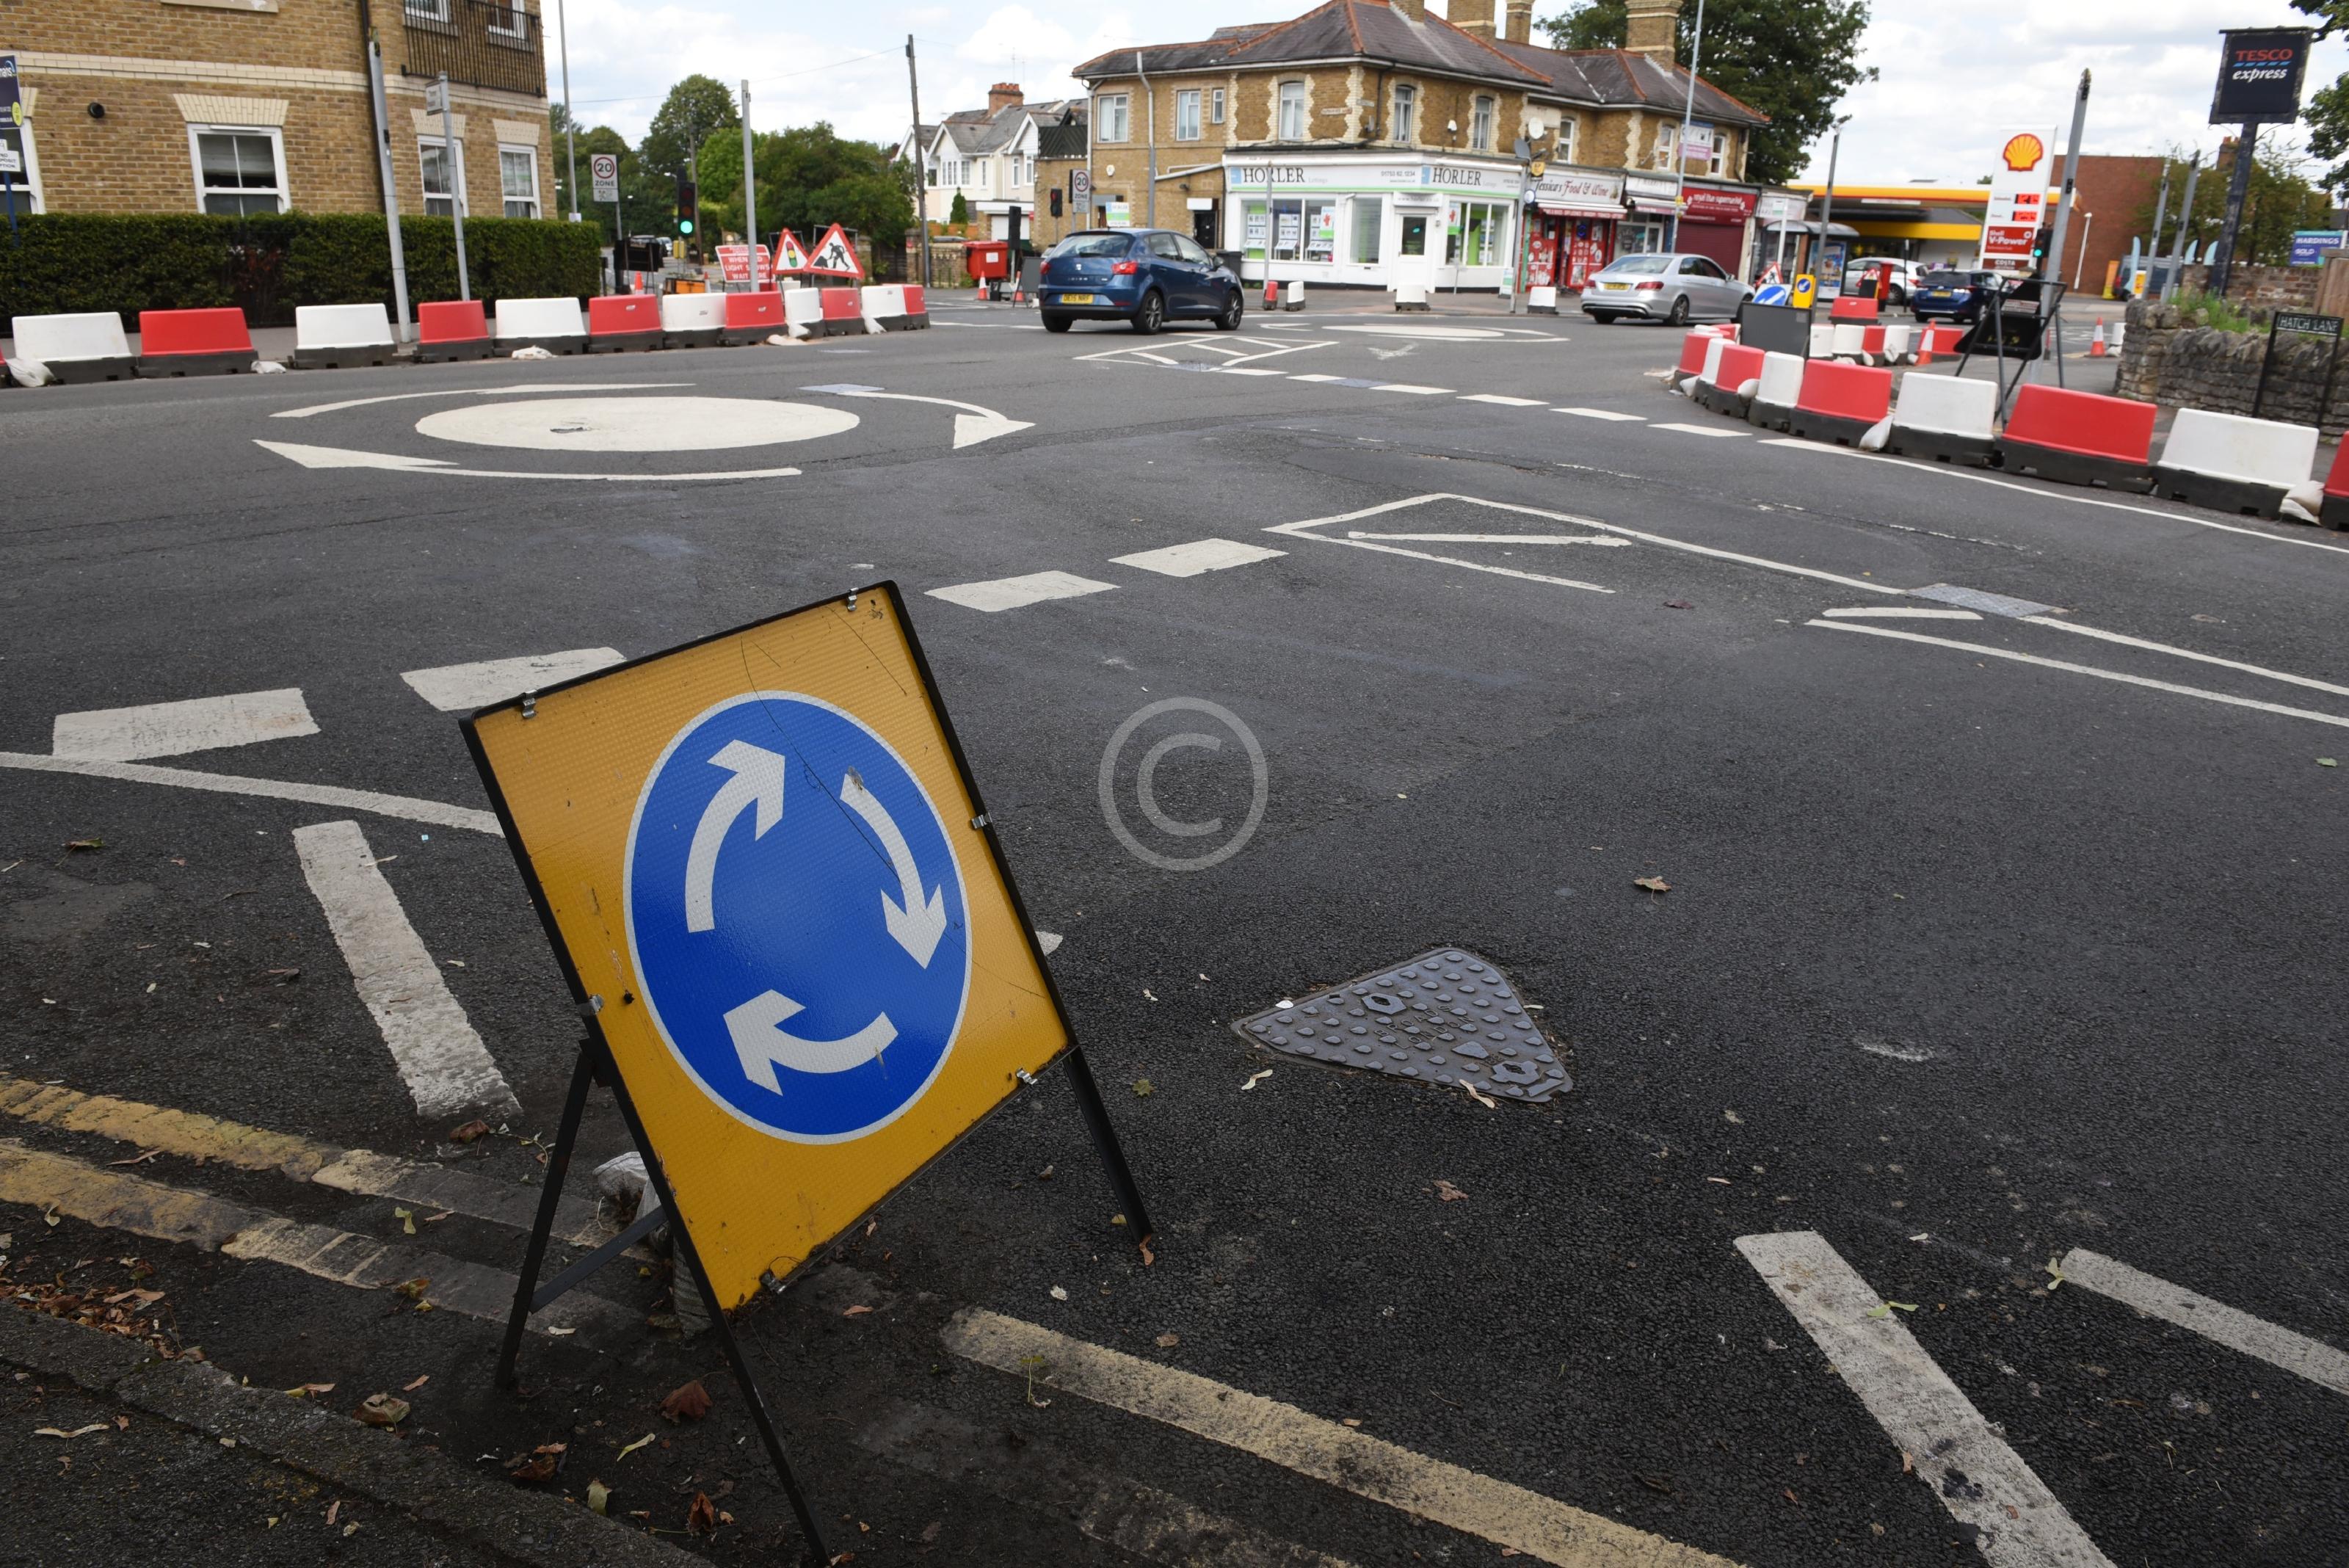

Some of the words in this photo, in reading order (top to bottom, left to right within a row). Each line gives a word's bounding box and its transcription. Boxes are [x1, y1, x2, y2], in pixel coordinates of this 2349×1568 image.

[2235, 48, 2294, 62] TESCO
[2232, 68, 2288, 83] express
[597, 163, 612, 173] 20
[1077, 177, 1087, 186] 20
[1432, 167, 1481, 186] HORLER
[1989, 236, 2027, 245] V-Power
[2279, 317, 2312, 330] HATCH
[2313, 321, 2339, 332] LANE
[1374, 1003, 1452, 1038] BROADS
